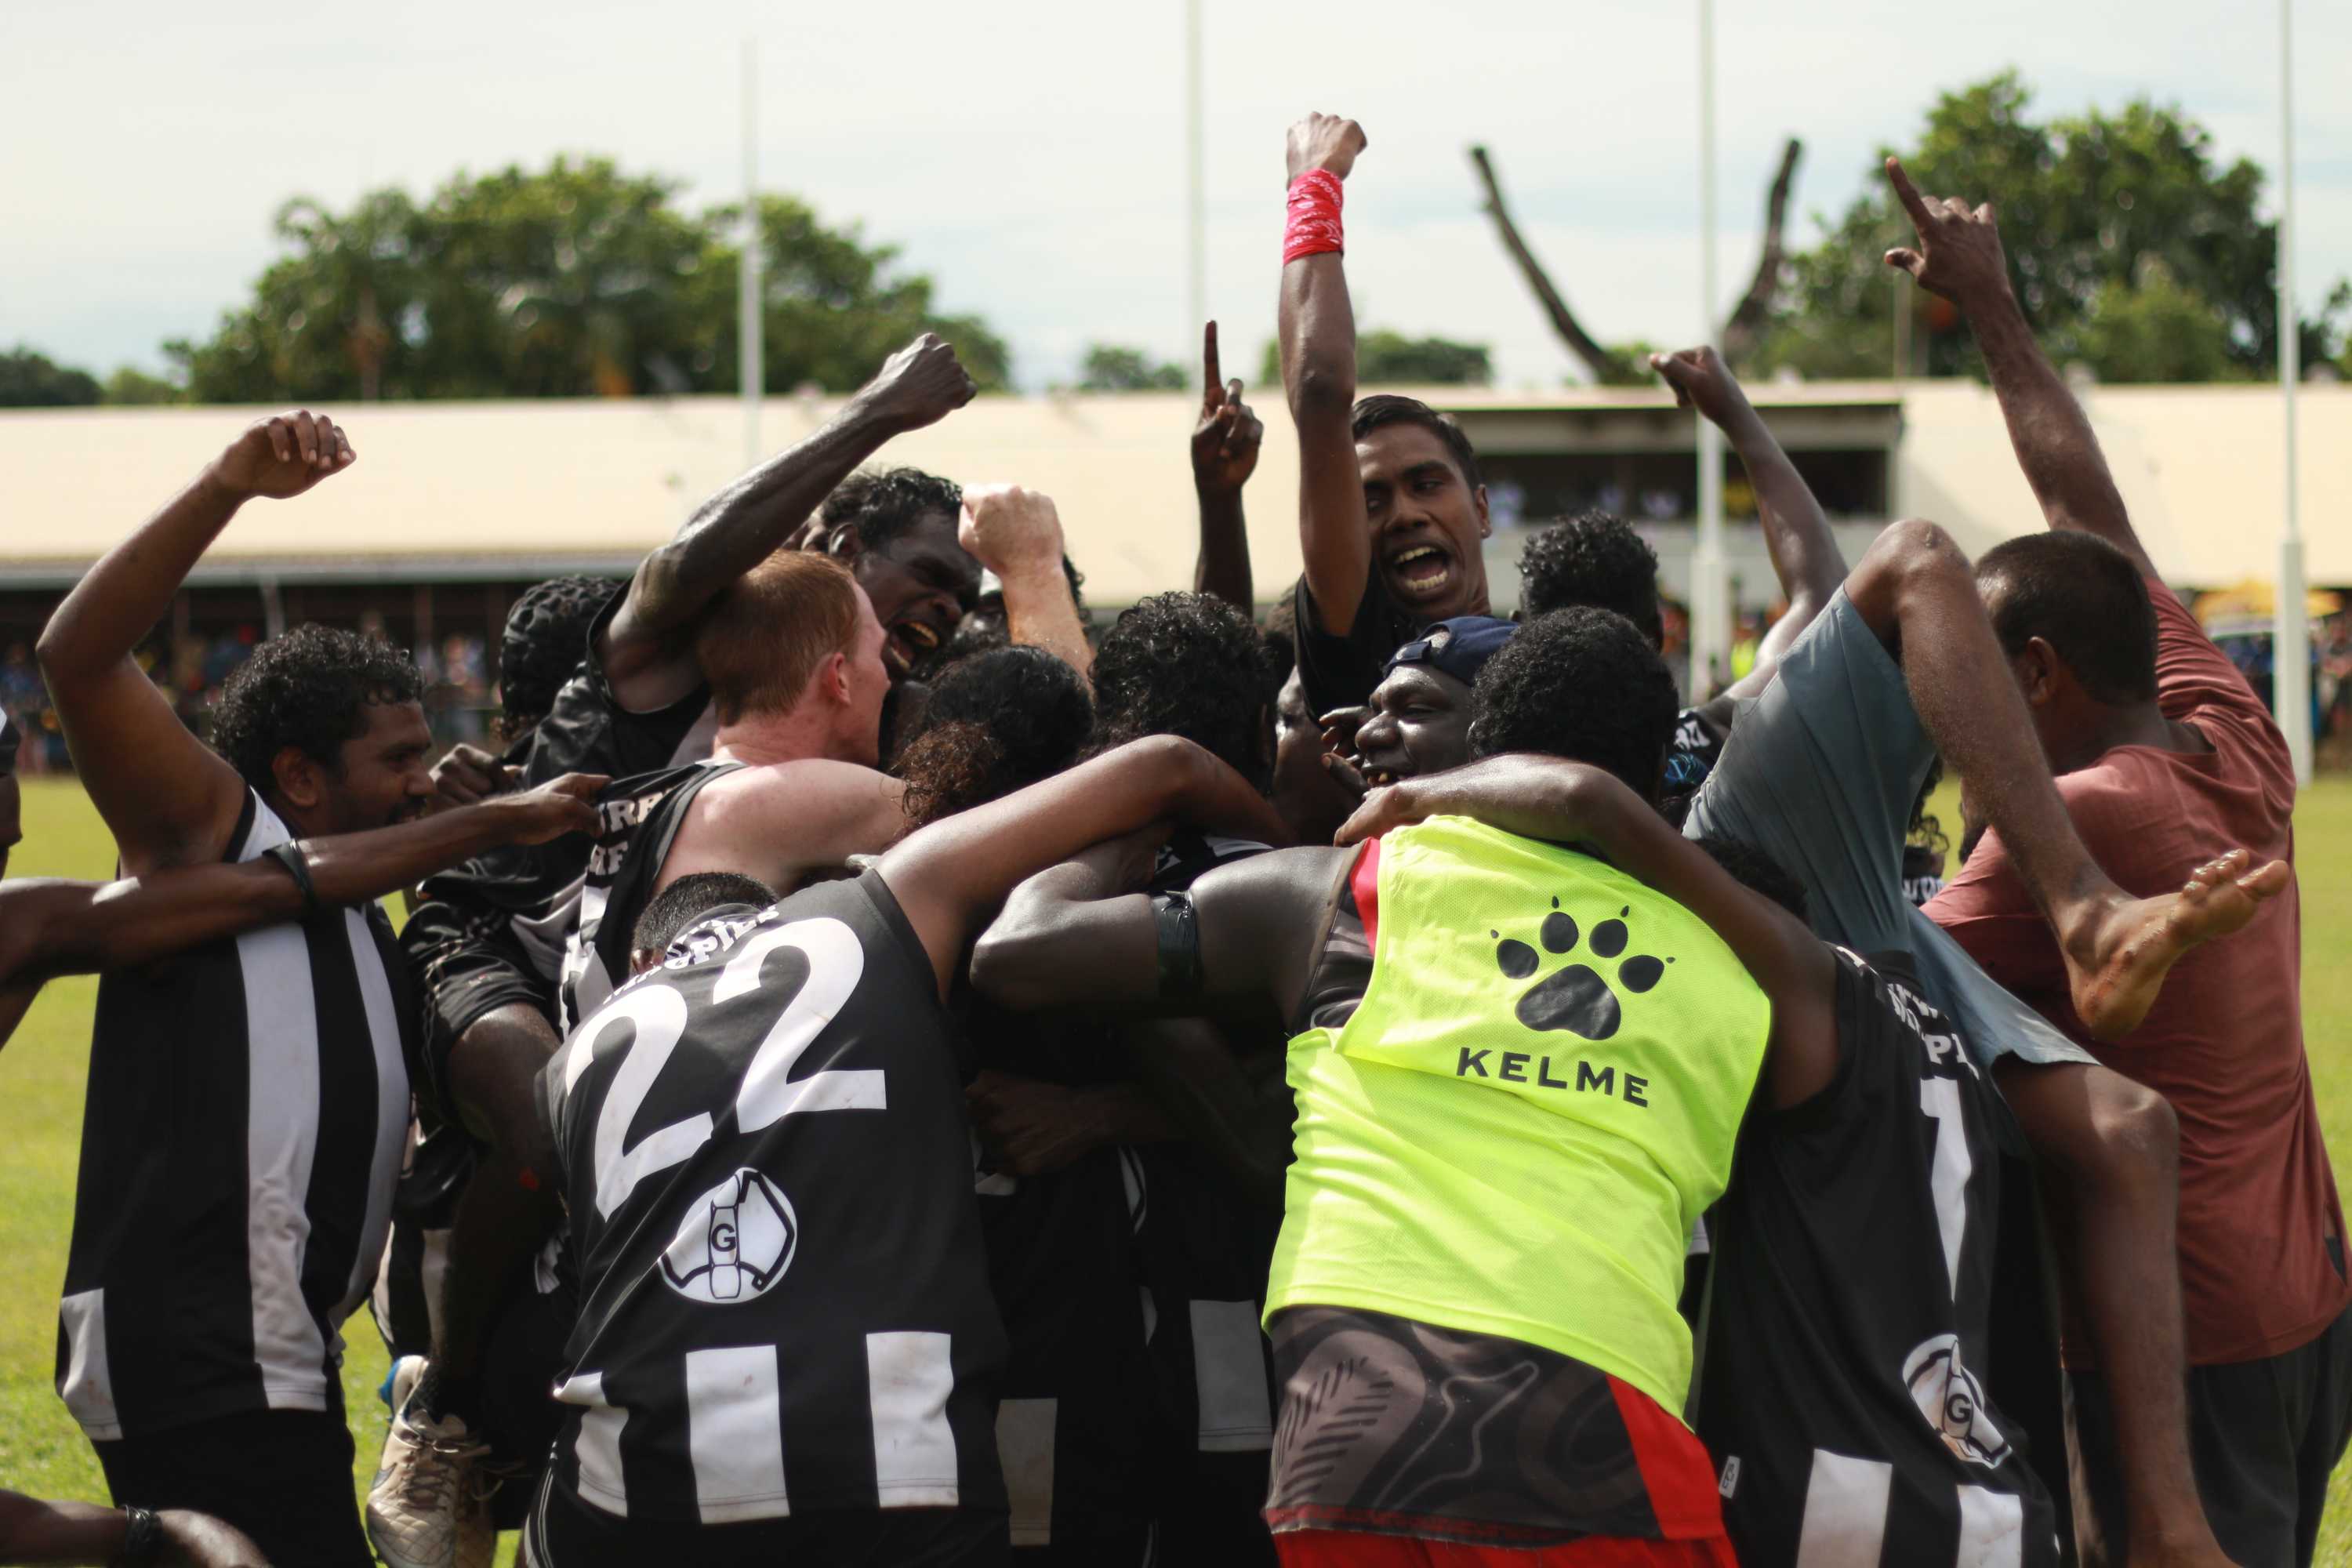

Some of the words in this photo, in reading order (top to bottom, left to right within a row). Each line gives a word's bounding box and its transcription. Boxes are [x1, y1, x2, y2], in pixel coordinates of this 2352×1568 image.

[566, 917, 887, 1223] 22
[1456, 1046, 1649, 1108] KELME
[711, 1223, 737, 1252] G
[1947, 1393, 1971, 1425] G
